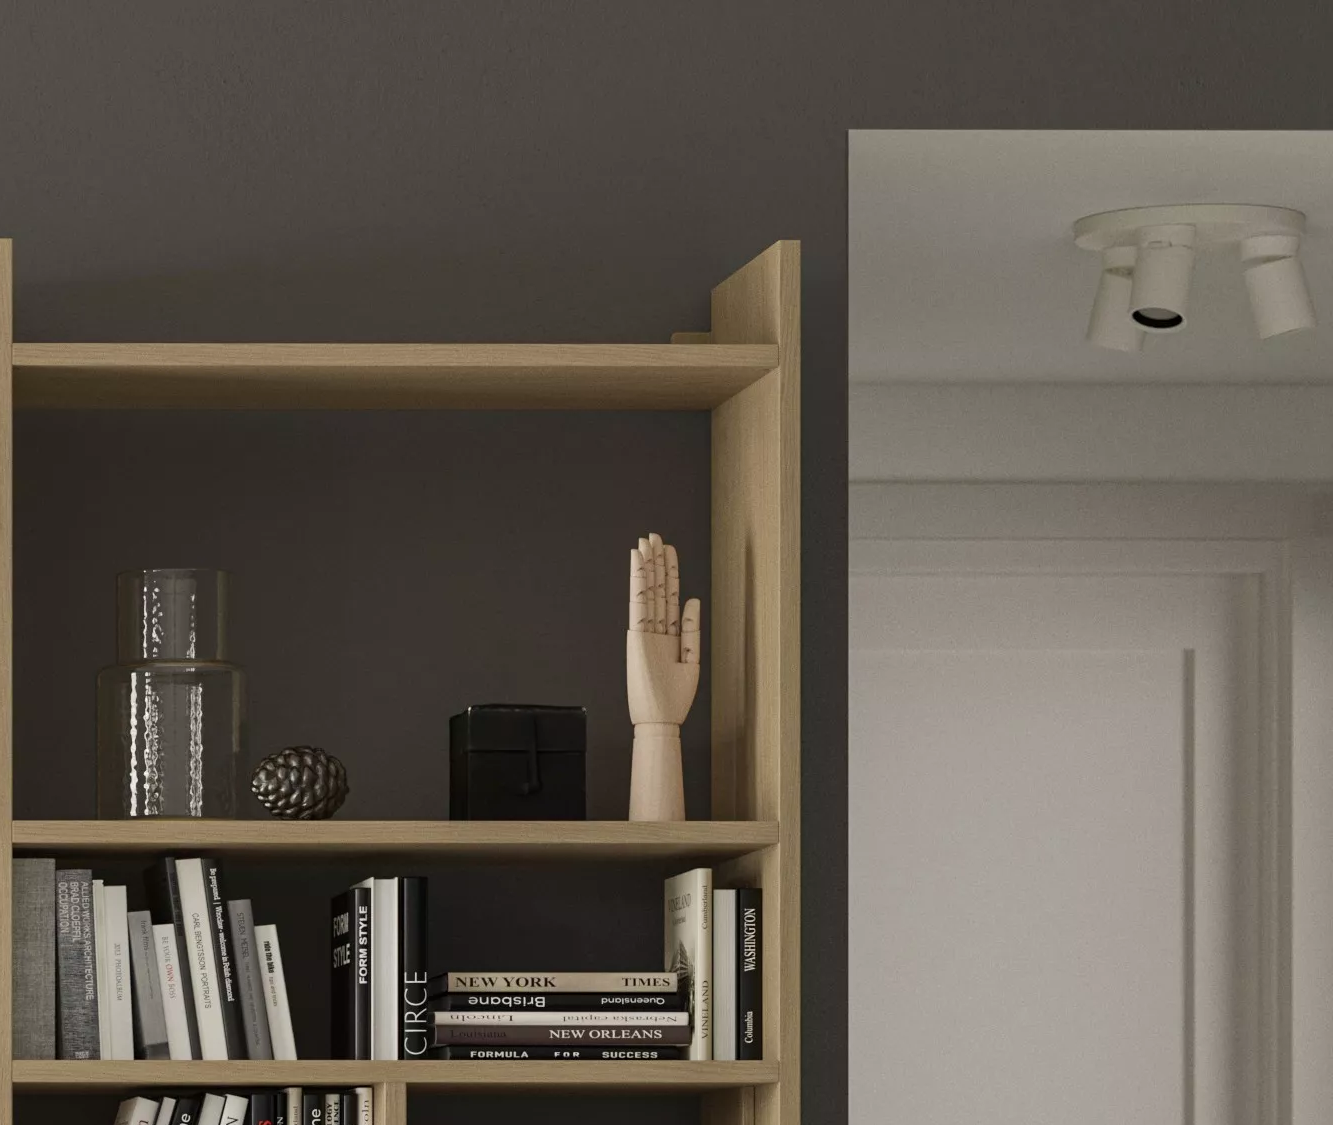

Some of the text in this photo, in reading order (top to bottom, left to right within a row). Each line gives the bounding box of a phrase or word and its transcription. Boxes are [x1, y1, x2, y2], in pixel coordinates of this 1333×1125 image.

[70, 882, 79, 904] BRAD
[210, 875, 220, 901] prepared
[58, 882, 70, 933] OCCUPATION
[237, 912, 246, 935] STEVEN
[333, 911, 349, 938] FORM
[81, 881, 94, 1001] ALLIED WORKS ARCHITECTURE
[218, 932, 228, 956] welcome
[358, 905, 368, 985] FORM STYLE
[192, 912, 212, 1009] CARL BENGTSSON PORTRAITS
[333, 943, 351, 969] STYLE
[165, 963, 174, 982] OWN
[223, 962, 232, 978] Polish
[454, 976, 671, 988] NEW YORK TIMES
[743, 907, 756, 1044] Columbia WASHINGTON
[225, 978, 235, 1002] diamond
[468, 996, 665, 1008] Brisbane Queensland
[404, 970, 428, 1057] CIRCE
[450, 1014, 513, 1022] Lincoln
[700, 979, 710, 1040] VINELAND
[449, 1029, 663, 1040] Louisiana NEW ORLEANS
[469, 1051, 529, 1059] FORMULA
[601, 1051, 658, 1059] SUCCESS
